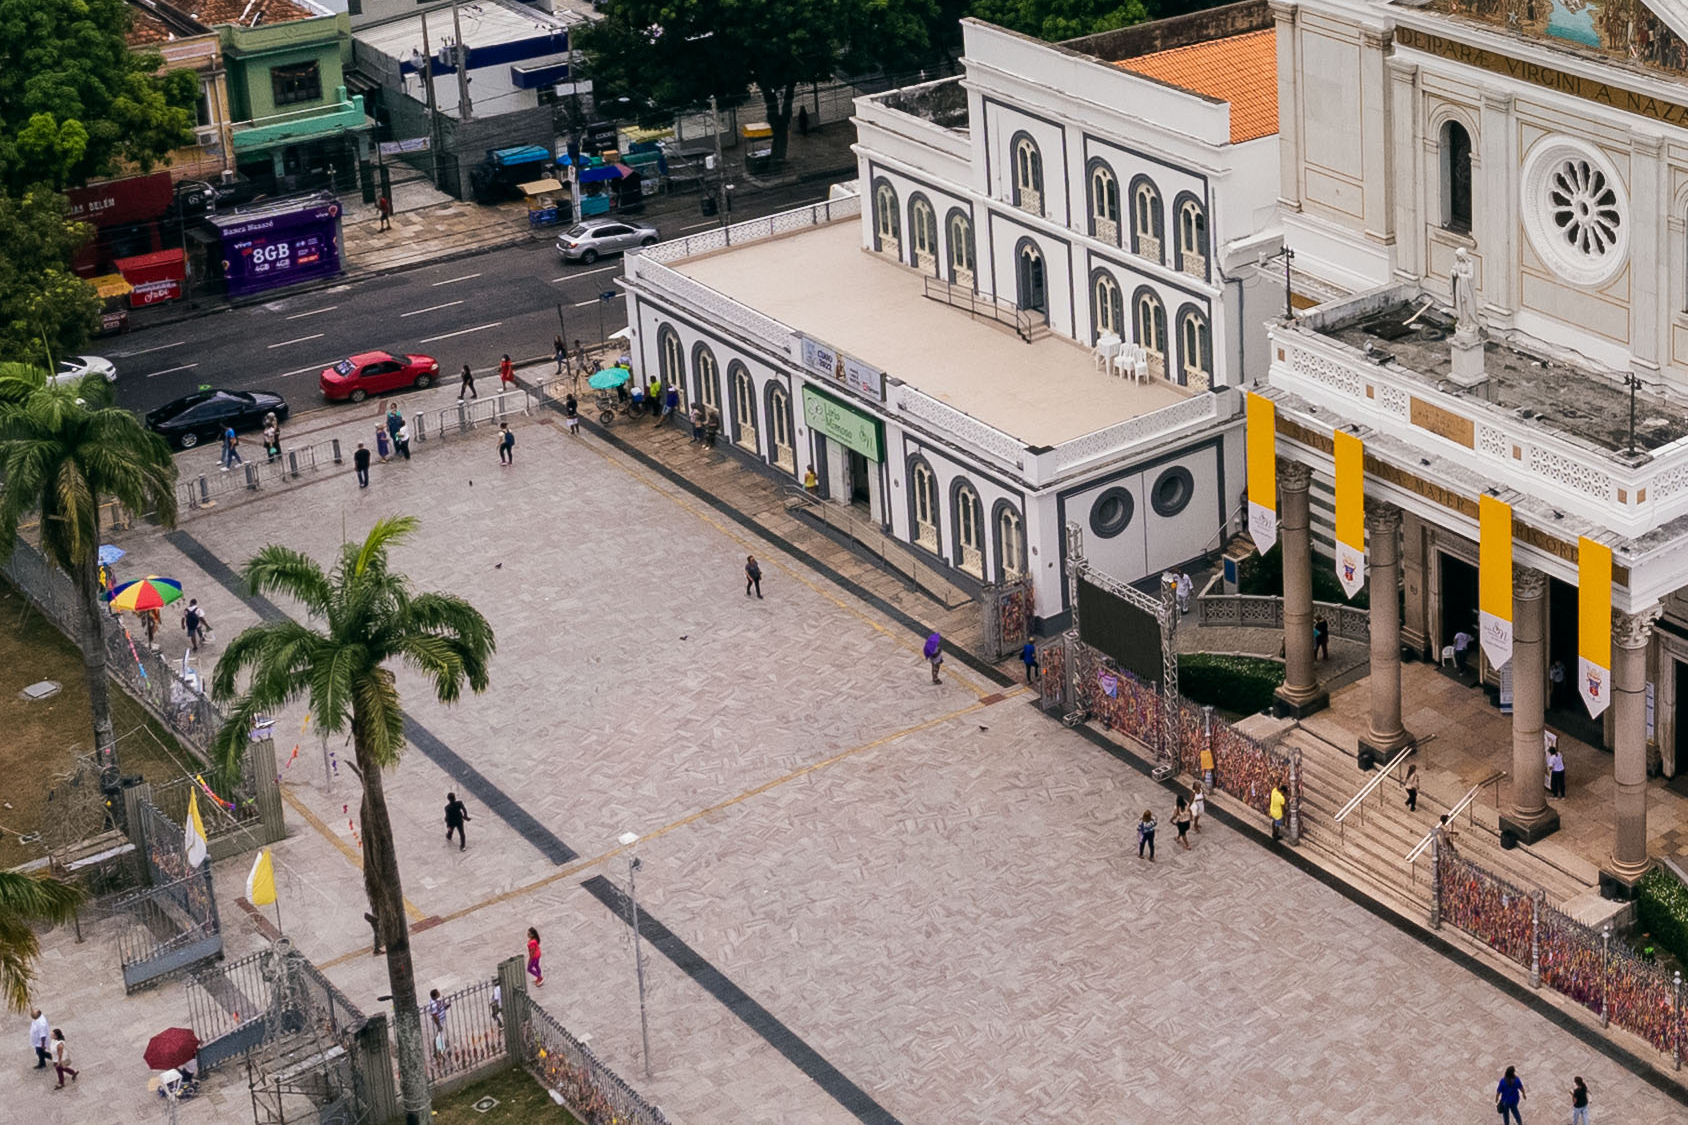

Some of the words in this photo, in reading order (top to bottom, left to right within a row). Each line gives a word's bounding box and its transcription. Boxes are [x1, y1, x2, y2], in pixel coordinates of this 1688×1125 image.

[1505, 58, 1581, 93] VIRGINI
[1595, 83, 1613, 103] A
[253, 243, 290, 264] 8GB
